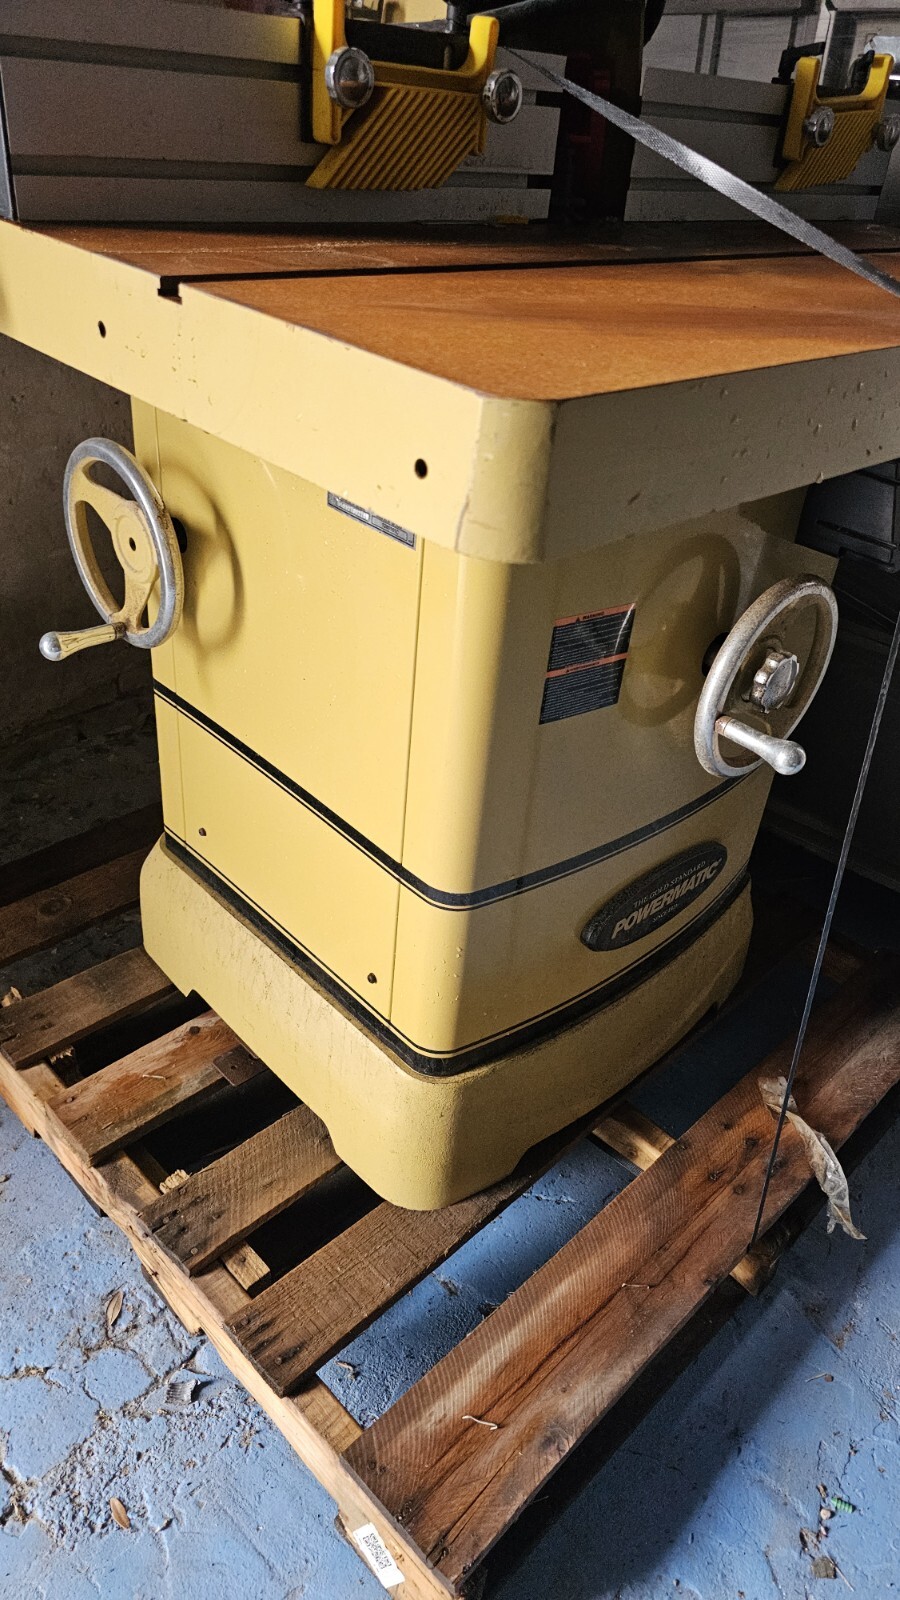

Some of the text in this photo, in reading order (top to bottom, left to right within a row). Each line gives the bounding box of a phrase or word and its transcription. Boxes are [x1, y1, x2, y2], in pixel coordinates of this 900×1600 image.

[611, 861, 720, 940] POWERMATIC
[633, 861, 706, 908] THE GOLD STANDARD
